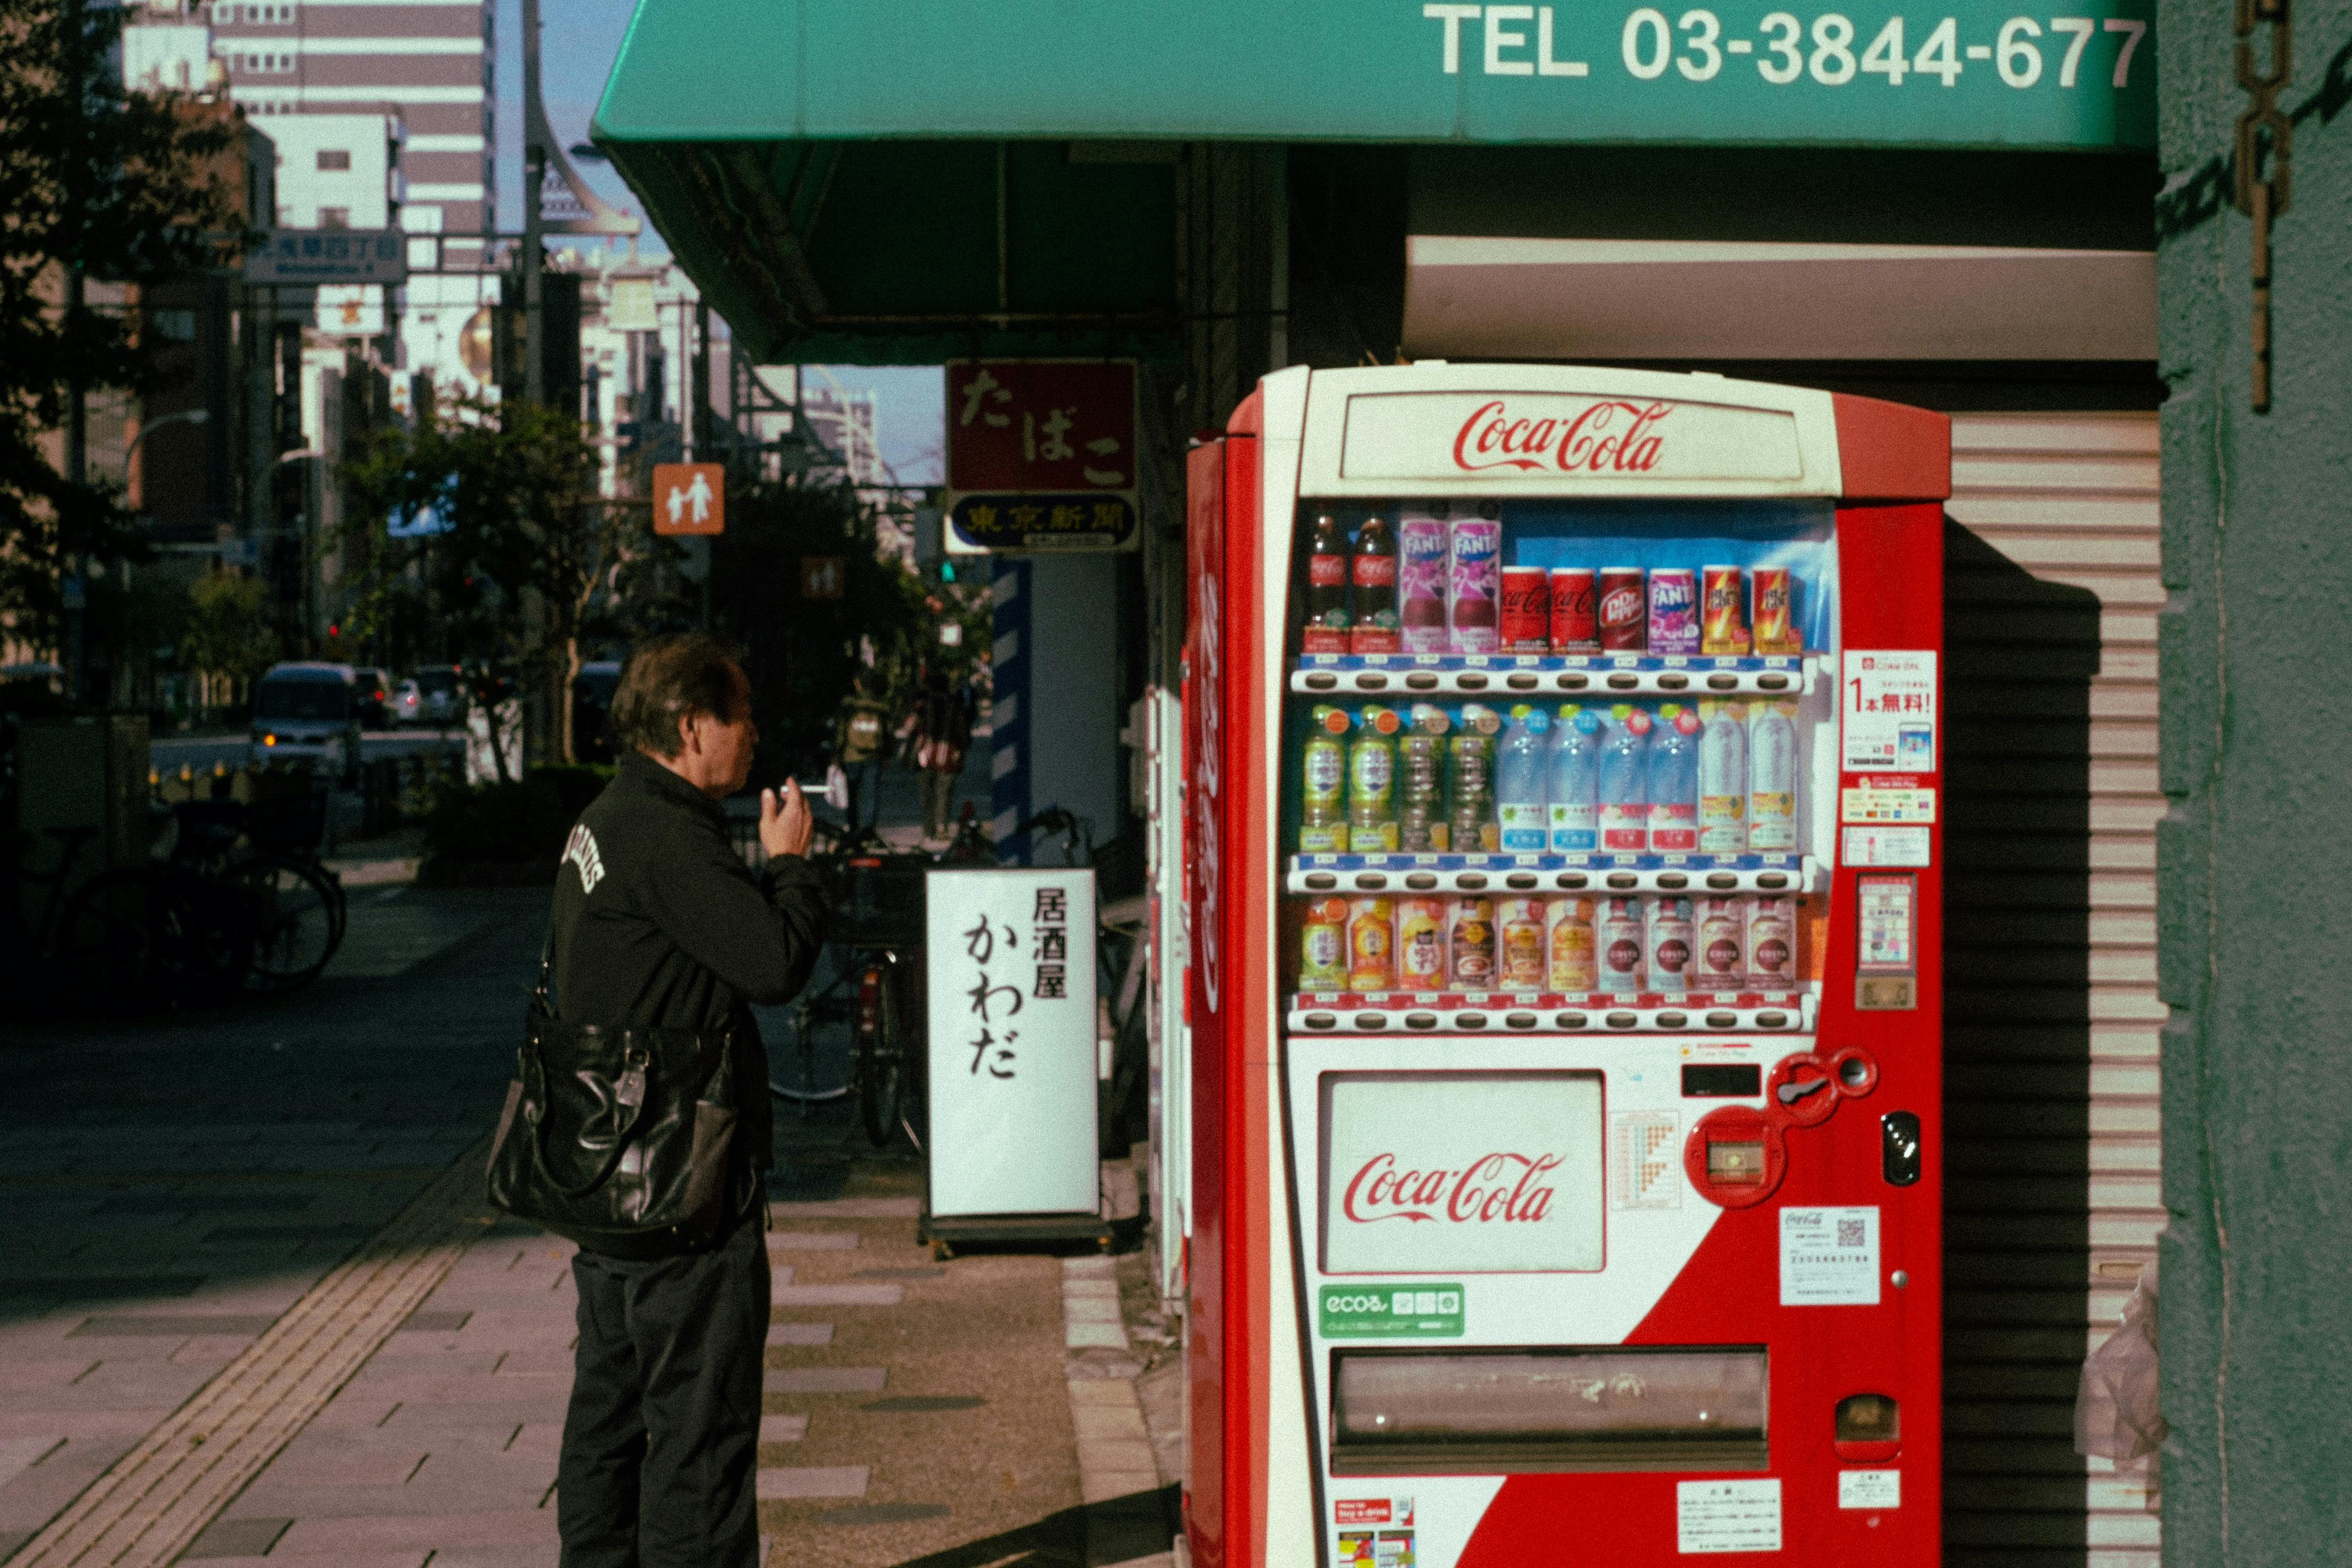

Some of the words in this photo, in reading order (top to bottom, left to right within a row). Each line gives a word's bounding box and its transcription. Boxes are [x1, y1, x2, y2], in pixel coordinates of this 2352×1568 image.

[1423, 3, 1589, 78] TEL
[961, 370, 1125, 485] たばこ
[1452, 401, 1678, 472] Coca-Cola
[965, 503, 1125, 533] 東京新聞
[1404, 535, 1442, 553] FANT
[1454, 535, 1495, 553] FANT
[1652, 585, 1692, 606] FANT
[1033, 887, 1068, 999] 居酒屋
[964, 913, 1024, 1079] かわだ
[1344, 1153, 1565, 1223] Coca-Cola
